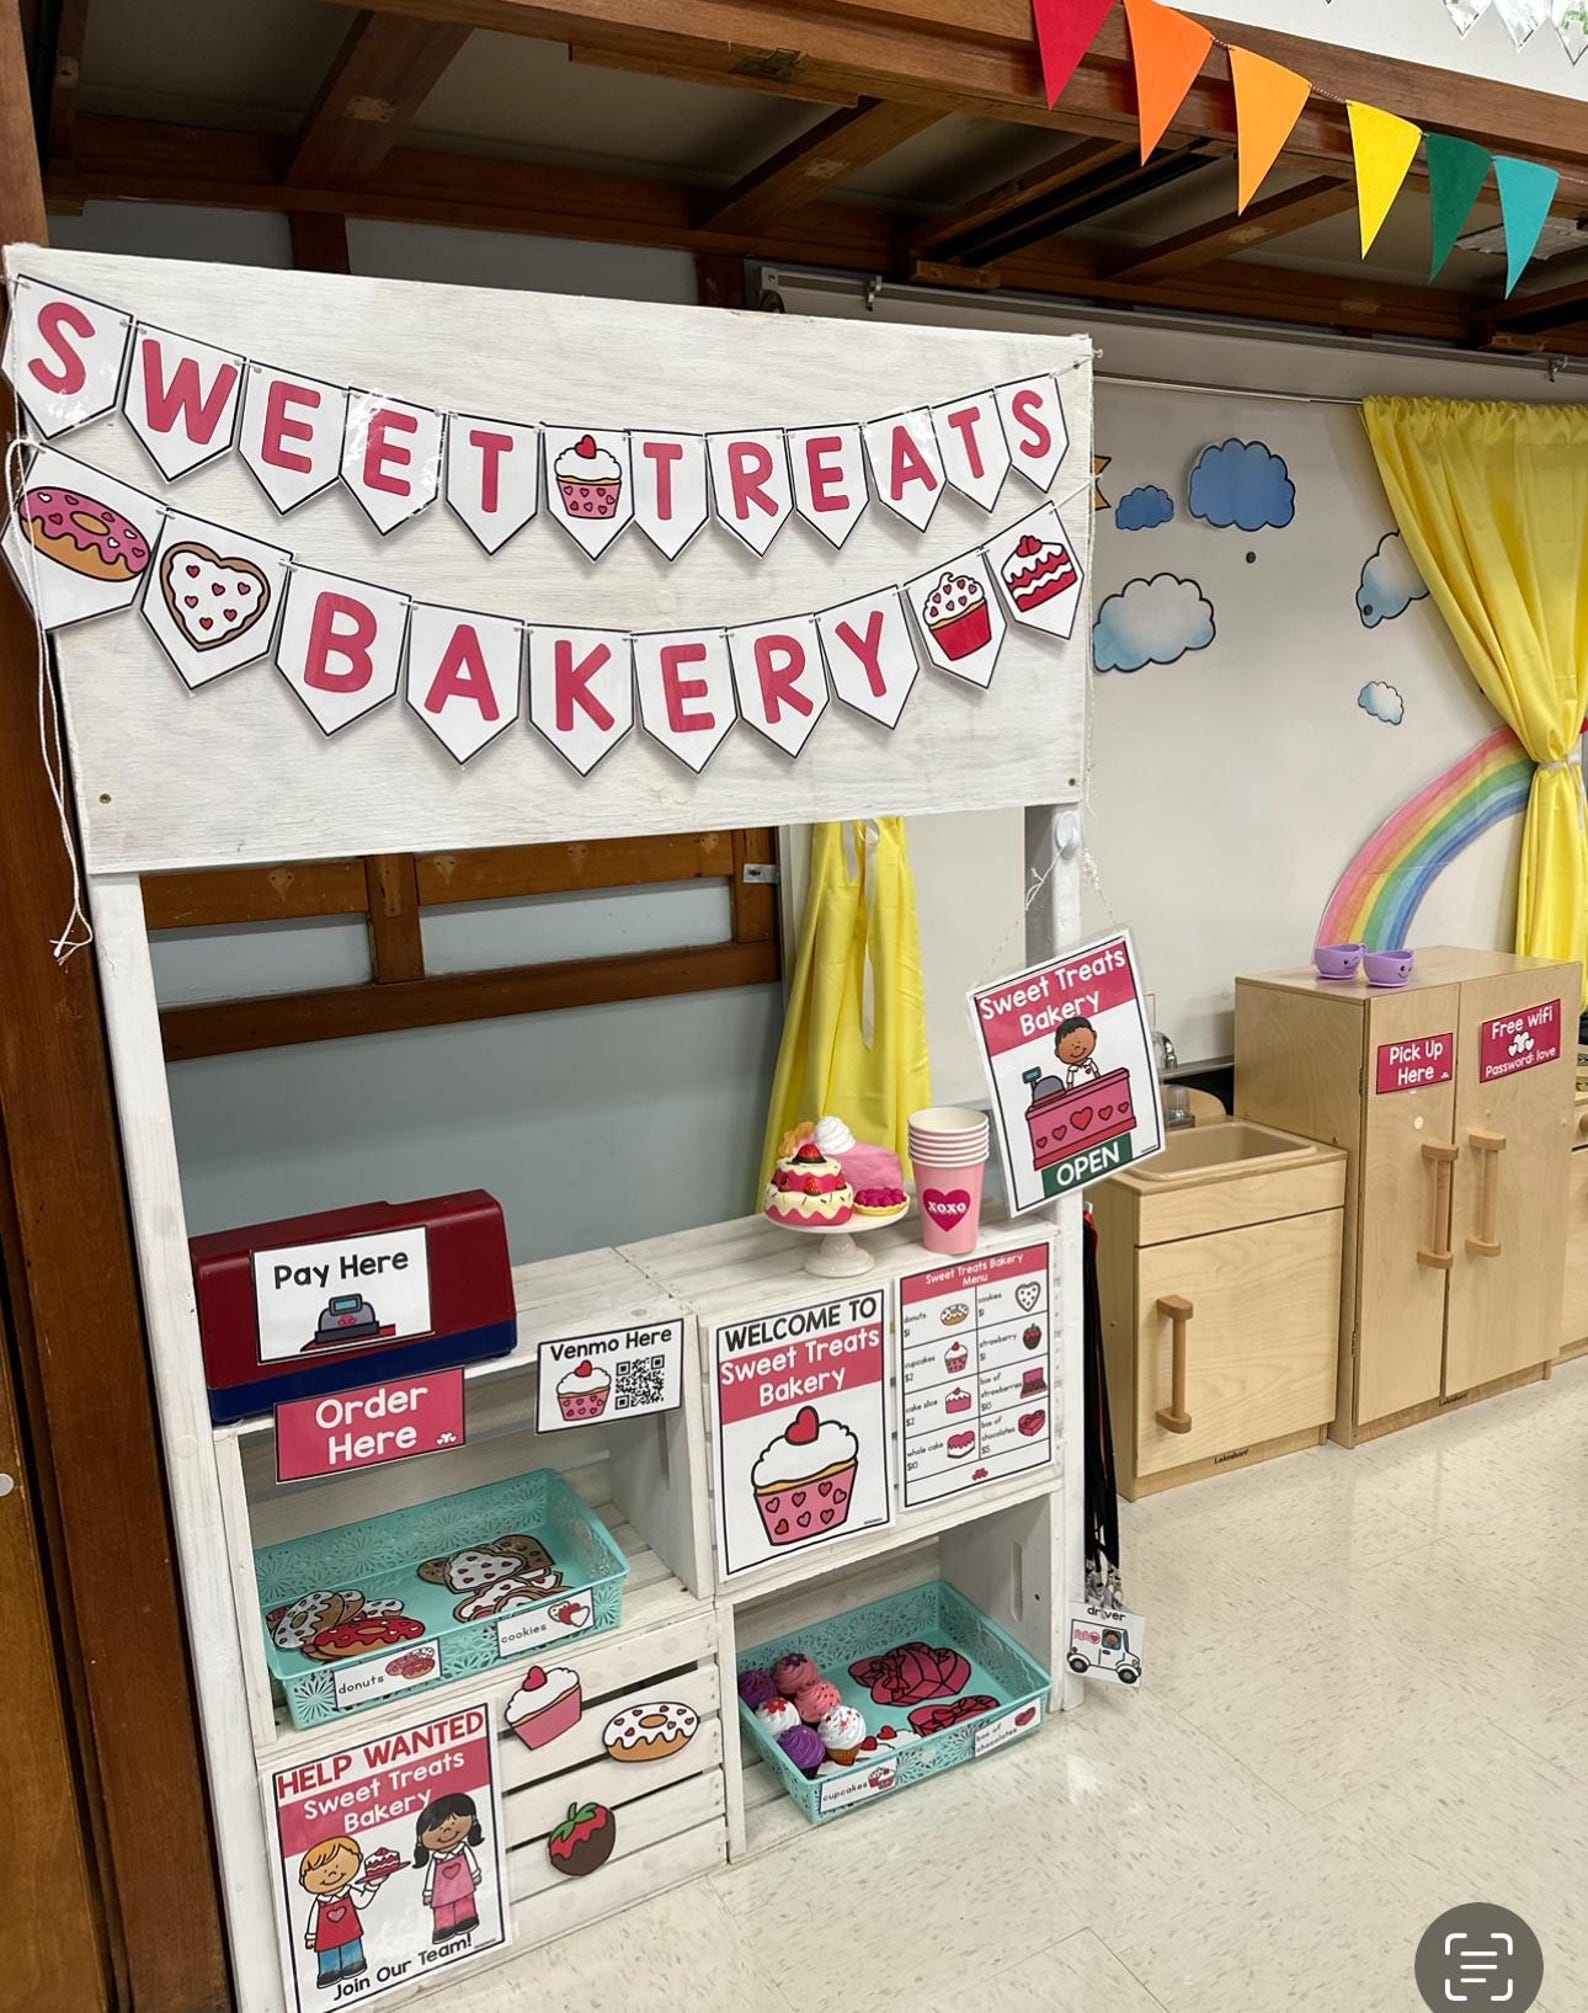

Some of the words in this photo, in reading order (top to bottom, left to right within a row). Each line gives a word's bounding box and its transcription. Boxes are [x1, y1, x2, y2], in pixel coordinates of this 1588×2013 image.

[27, 301, 514, 514] SWEET
[643, 389, 1052, 521] TREATS
[304, 590, 884, 733] BAKERY
[980, 976, 1050, 1020] Sweet
[1055, 948, 1126, 989] Treats
[1019, 991, 1100, 1037] Bakery
[1491, 1017, 1524, 1039] Free
[1389, 1045, 1421, 1065] Pick
[1425, 1040, 1443, 1061] Up
[1536, 1047, 1556, 1062] love
[1397, 1066, 1434, 1086] Here
[1056, 1141, 1120, 1187] OPEN
[273, 1263, 330, 1289] Pay
[340, 1251, 409, 1279] Here
[926, 1270, 954, 1285] Sweet
[957, 1262, 988, 1276] Treats
[989, 1253, 1024, 1269] Bakery
[962, 1274, 989, 1287] Menu
[725, 1304, 841, 1352] WELCOME
[849, 1296, 877, 1323] TO
[550, 1338, 620, 1361] Venmo
[626, 1328, 672, 1349] Here
[721, 1346, 797, 1385] Sweet
[805, 1327, 880, 1364] Treats
[315, 1385, 429, 1430] Order
[759, 1367, 846, 1408] Bakery
[327, 1425, 418, 1465] Here
[1087, 1604, 1126, 1621] drver
[500, 1621, 548, 1645] cookies
[338, 1673, 385, 1695] donuts
[277, 1755, 352, 1799] HELP
[363, 1711, 484, 1769] WANTED
[303, 1779, 381, 1820] Sweet
[388, 1752, 465, 1791] Treats
[822, 1782, 868, 1802] cupcakes
[343, 1789, 432, 1834] Bakery
[333, 1976, 371, 2001] Join
[376, 1960, 412, 1983] Our
[417, 1932, 472, 1966] Team!
